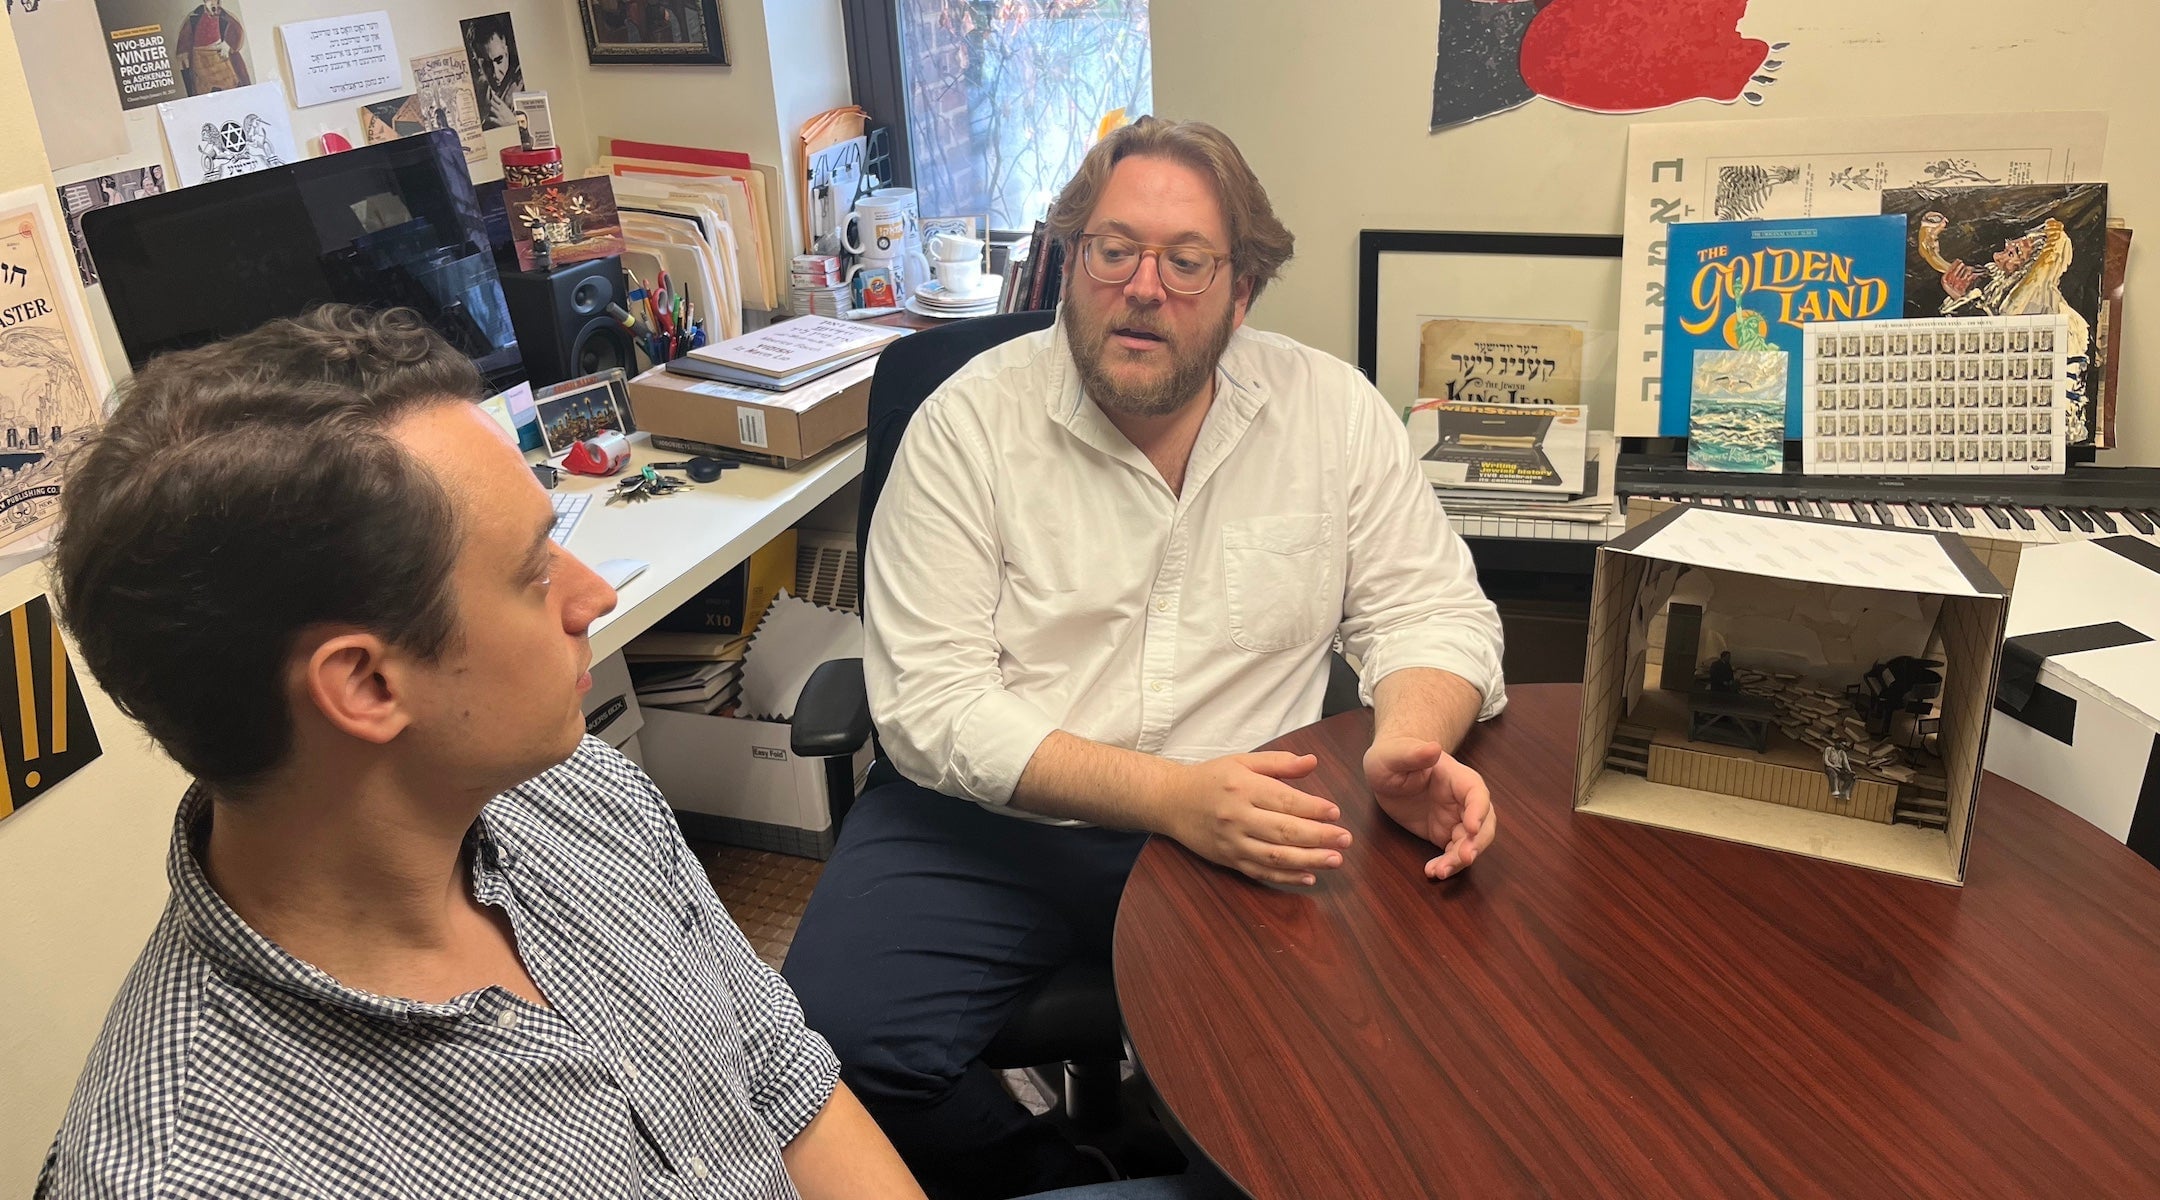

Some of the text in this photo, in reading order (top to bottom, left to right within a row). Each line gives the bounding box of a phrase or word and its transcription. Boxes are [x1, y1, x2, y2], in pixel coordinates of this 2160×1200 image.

[114, 36, 164, 52] YIVO-BARD
[116, 46, 168, 66] WINTER
[120, 59, 171, 77] PROGRAM
[124, 77, 174, 94] CIVILIZATION
[133, 70, 173, 84] ASHKENAZI
[1697, 245, 1728, 262] THE
[1680, 246, 1854, 335] GOLDEN
[1778, 276, 1889, 330] LAND
[0, 298, 53, 329] STER
[1516, 344, 1538, 356] דער
[1450, 351, 1556, 382] קעניג ליער
[1481, 461, 1517, 470] Writing
[1517, 469, 1553, 477] history
[6, 487, 46, 506] PUBLISHING
[705, 613, 732, 628] X10
[588, 711, 609, 730] NKERS
[753, 749, 784, 759] Easy Fold
